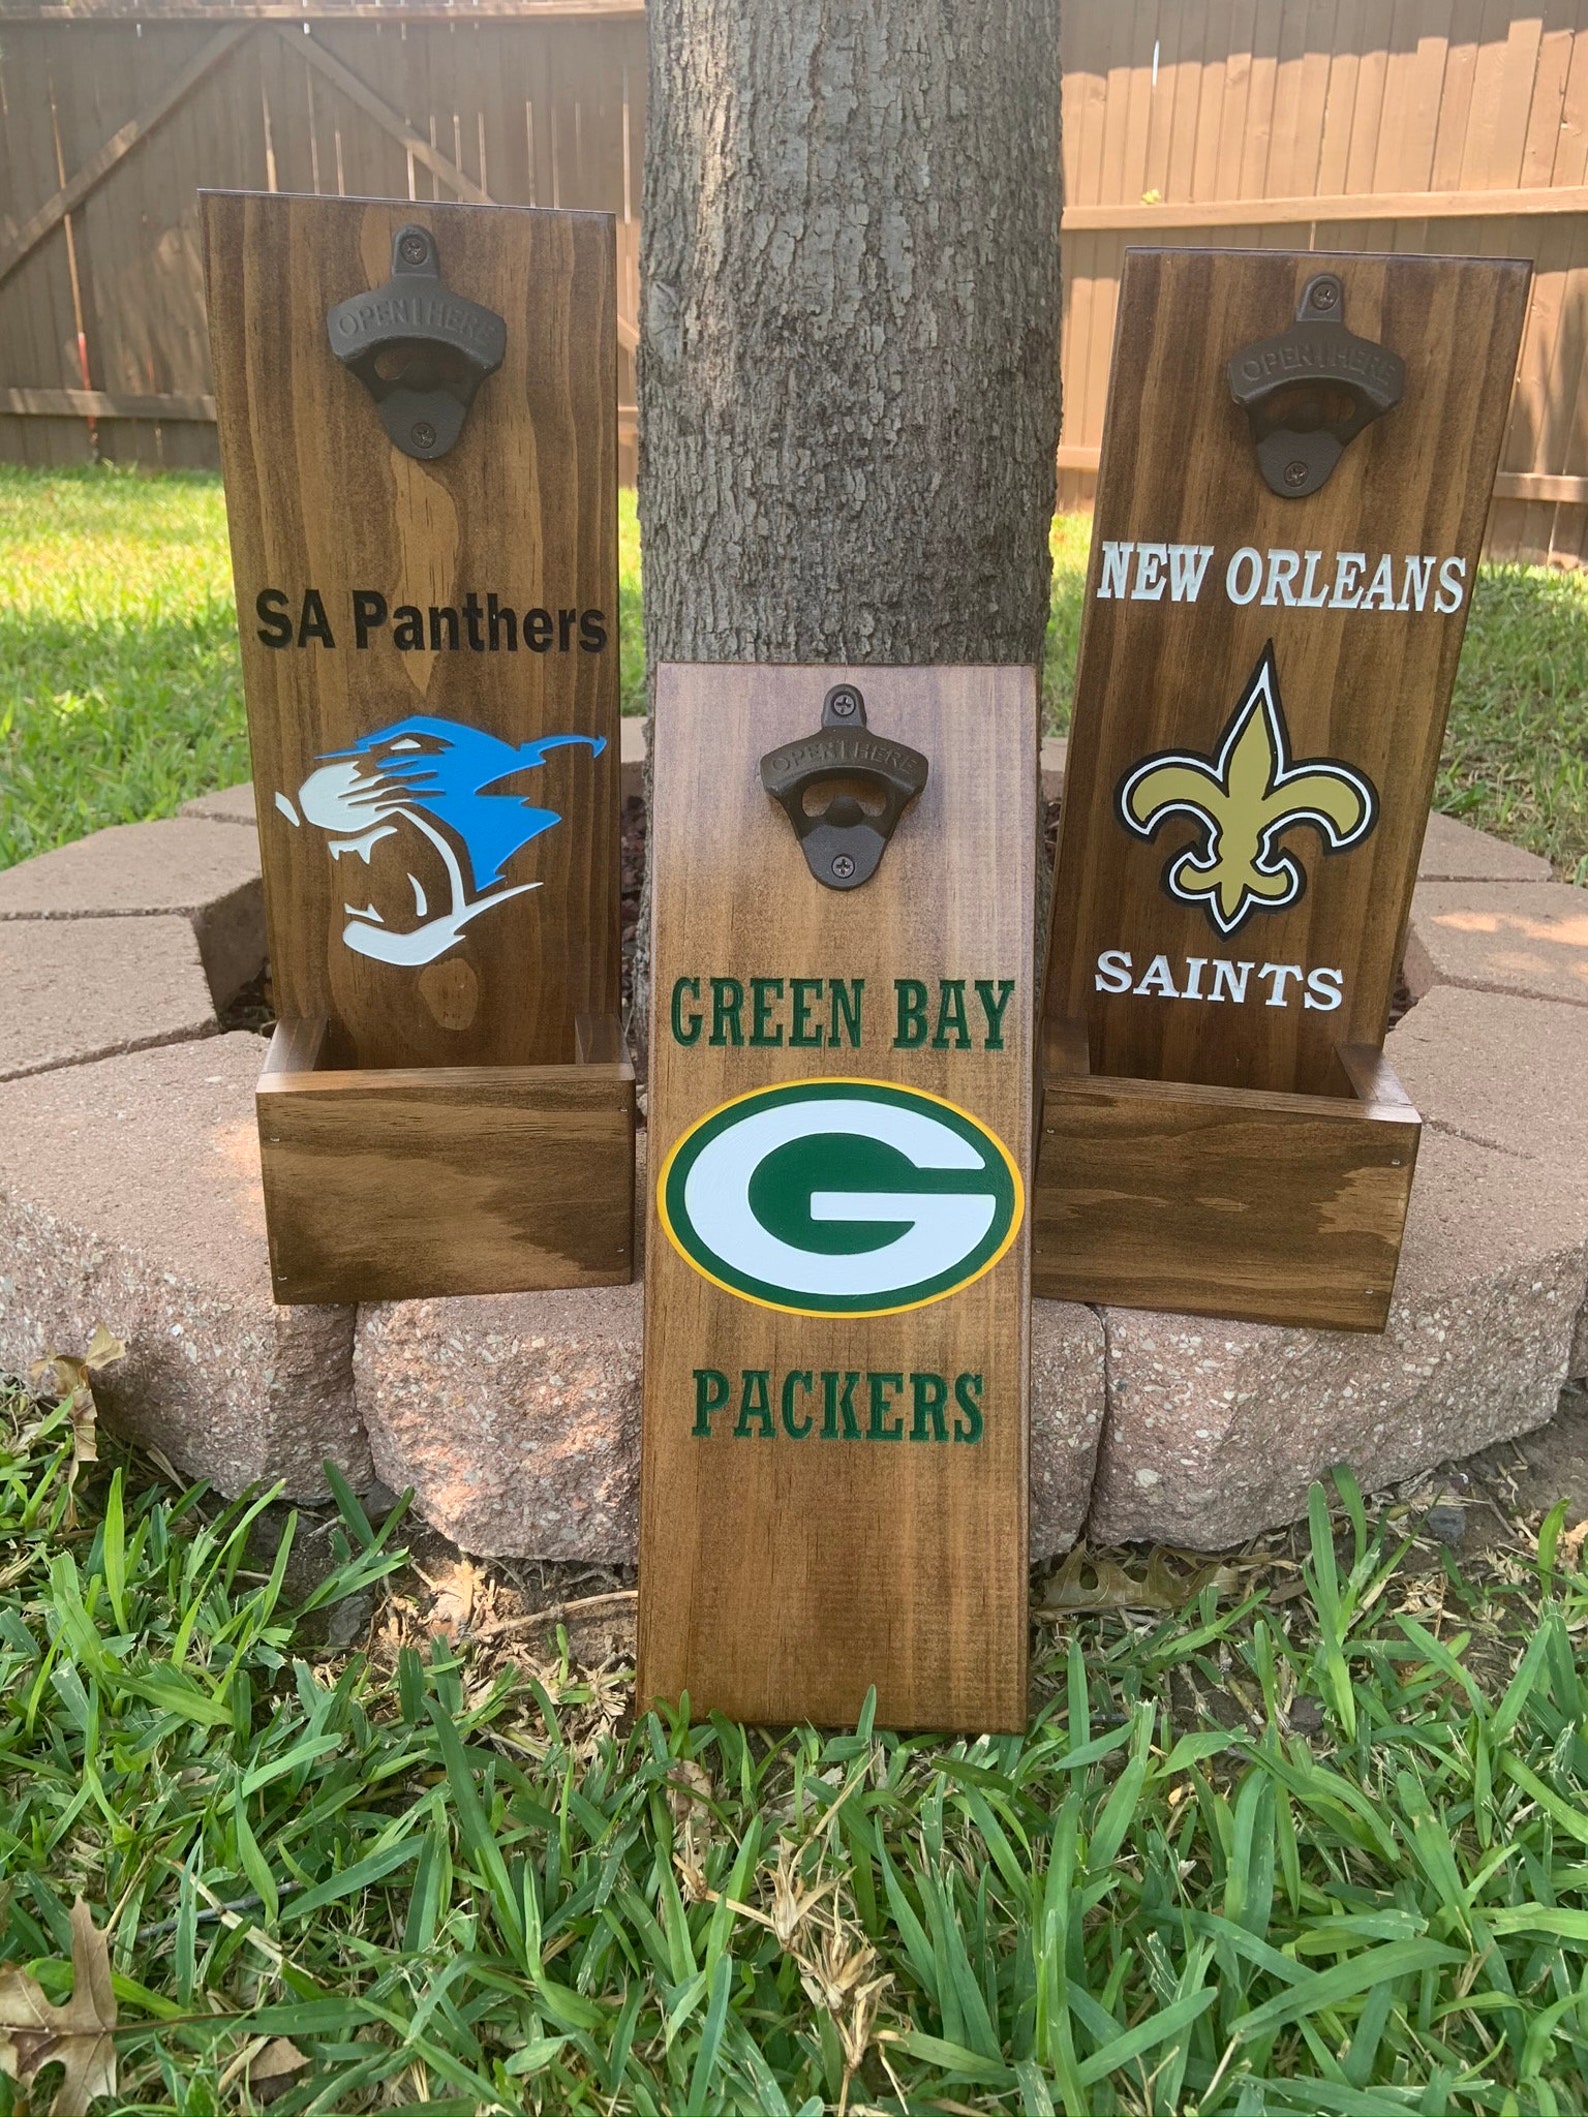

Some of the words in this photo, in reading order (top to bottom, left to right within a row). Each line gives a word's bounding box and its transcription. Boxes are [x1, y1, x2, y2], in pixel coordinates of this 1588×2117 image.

[1096, 541, 1215, 603] NEW
[1225, 546, 1466, 614] ORLEANS
[255, 588, 336, 649] SA
[352, 589, 608, 653] Panthers
[670, 976, 866, 1048] GREEN
[893, 979, 1016, 1050] BAY
[1094, 950, 1344, 1011] SAINTS
[684, 1099, 997, 1295] G
[691, 1369, 984, 1443] PACKERS
